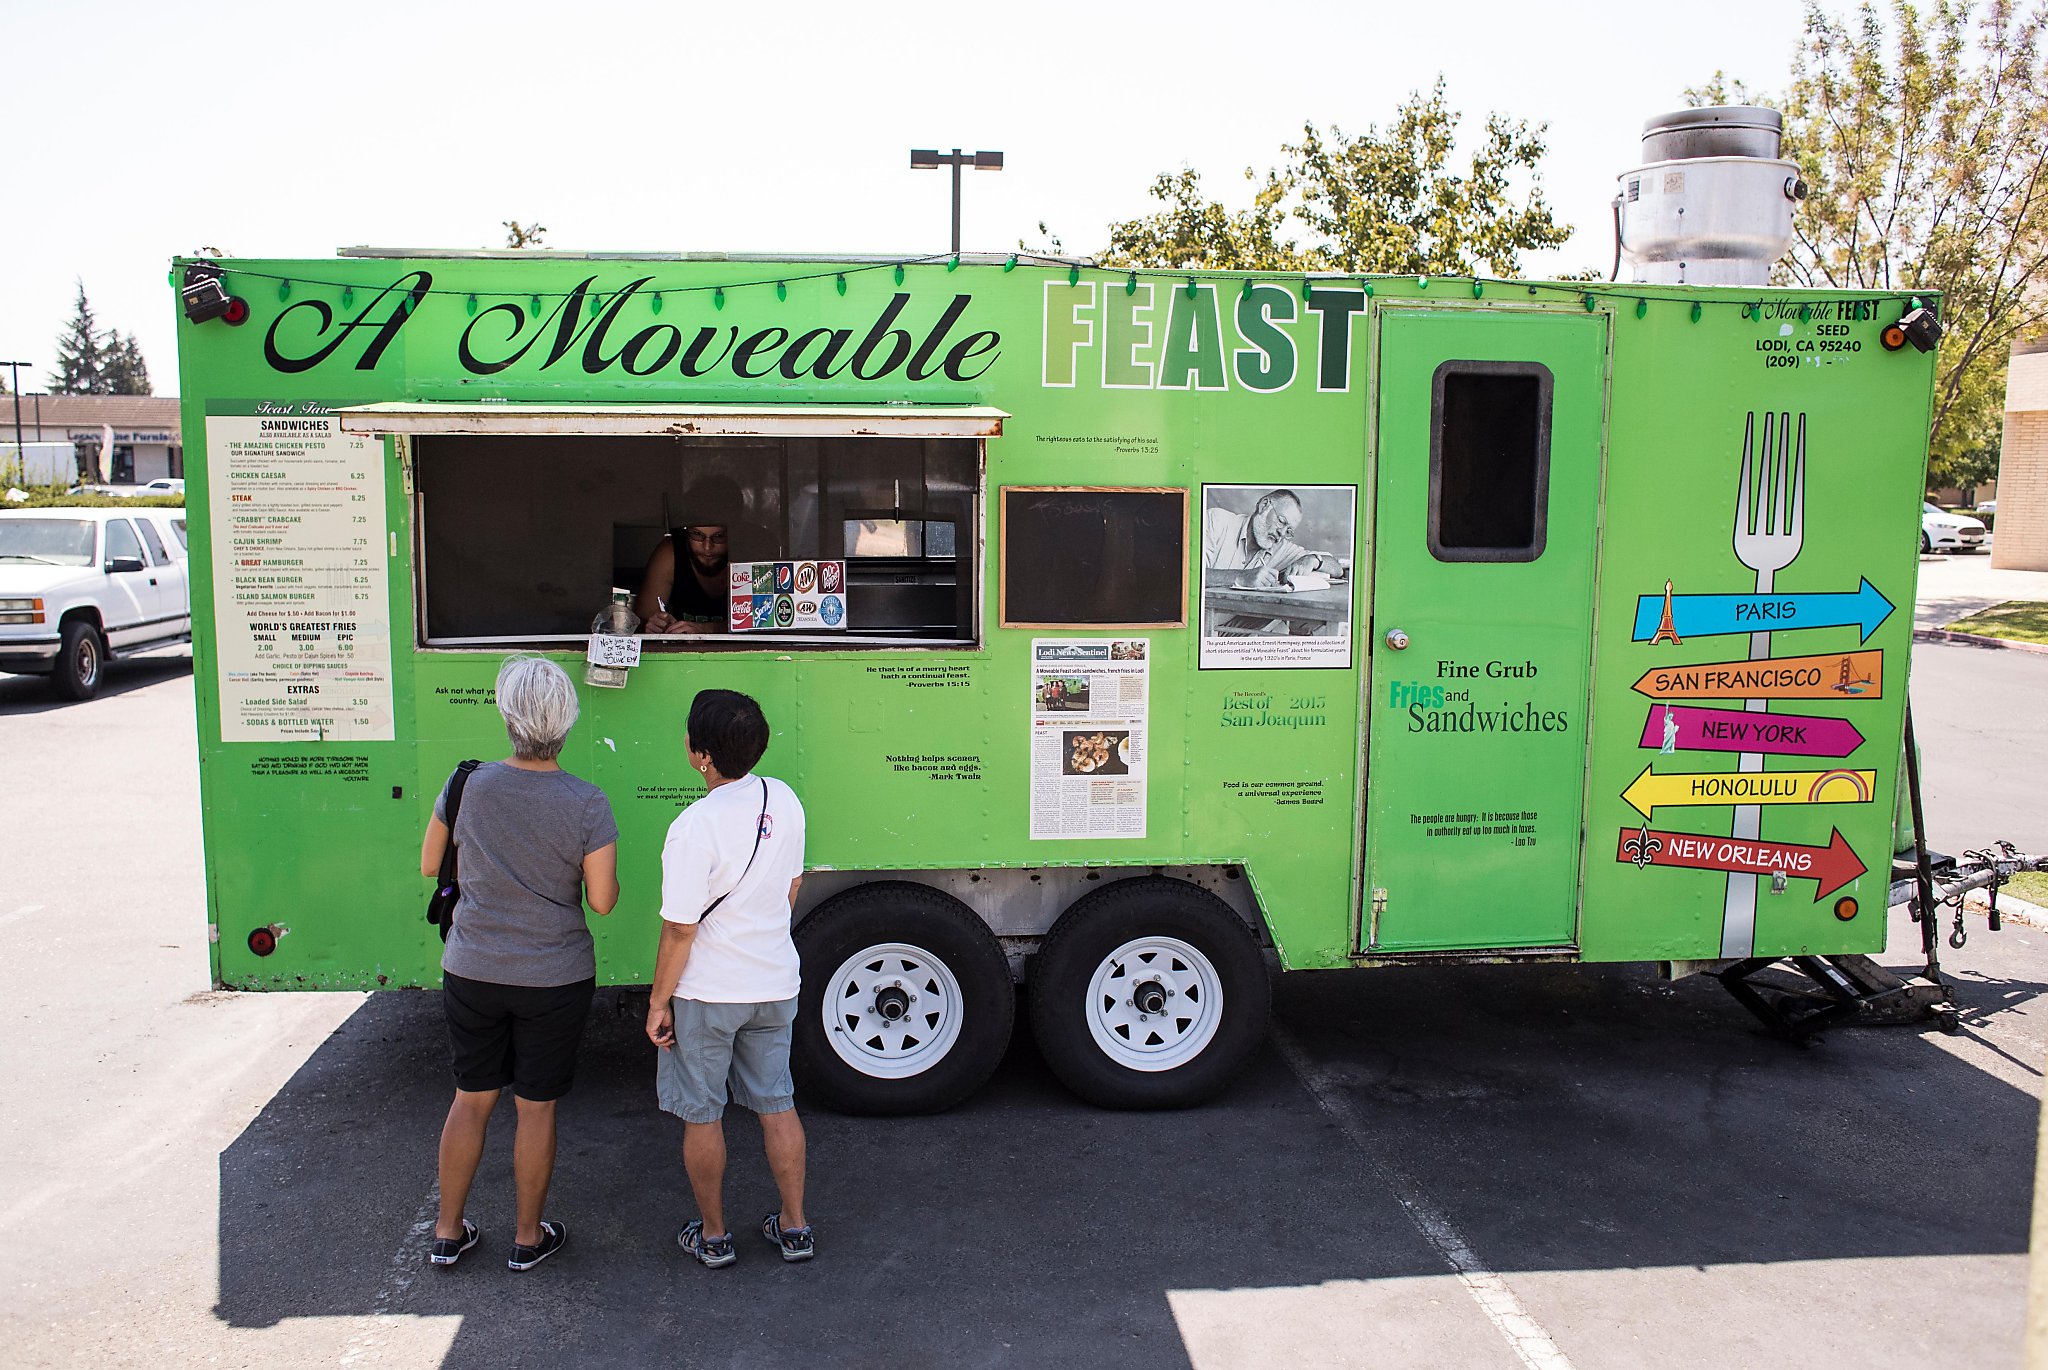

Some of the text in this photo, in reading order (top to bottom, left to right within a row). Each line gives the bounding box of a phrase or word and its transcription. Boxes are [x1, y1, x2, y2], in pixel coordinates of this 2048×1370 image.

[1765, 297, 1833, 320] Movable
[264, 271, 1368, 393] A Moveable FEAST
[1816, 325, 1850, 336] SEED
[1756, 340, 1861, 353] LODI, CA 95240
[1765, 355, 1799, 368] (209)
[261, 420, 329, 430] SANDWICHES
[1103, 437, 1130, 445] satisfying
[732, 572, 750, 582] Coke
[1736, 602, 1796, 621] PARIS
[250, 623, 357, 631] WORLD'S GREATEST FRIES
[1038, 648, 1055, 656] Lodi
[1436, 660, 1537, 678] Fine Grub
[1655, 668, 1821, 691] SAN FRANCISCO
[287, 686, 320, 694] EXTRAS
[1390, 681, 1469, 709] Fries and
[449, 698, 479, 706] country.
[1223, 696, 1254, 709] Best
[1256, 696, 1273, 709] of
[1221, 711, 1326, 729] San Joaquin
[1408, 702, 1568, 733] Sandwiches
[1701, 721, 1807, 744] NEW YORK
[886, 755, 919, 763] Nothing
[958, 764, 981, 772] eggs.
[1691, 778, 1797, 796] HONOLULU
[1410, 814, 1421, 824] The
[1423, 814, 1443, 824] people
[1445, 814, 1454, 823] are
[1481, 812, 1486, 821] It
[1488, 812, 1493, 821] is
[1495, 812, 1519, 821] because
[1521, 811, 1537, 820] those
[1427, 827, 1433, 836] in
[1434, 826, 1461, 836] authority
[1462, 826, 1472, 835] eat
[1474, 826, 1480, 835] up
[1482, 825, 1491, 834] too
[1493, 825, 1510, 834] much
[1512, 824, 1517, 833] in
[1515, 836, 1536, 846] Lao Tzu
[1668, 839, 1812, 871] NEW ORLEANS
